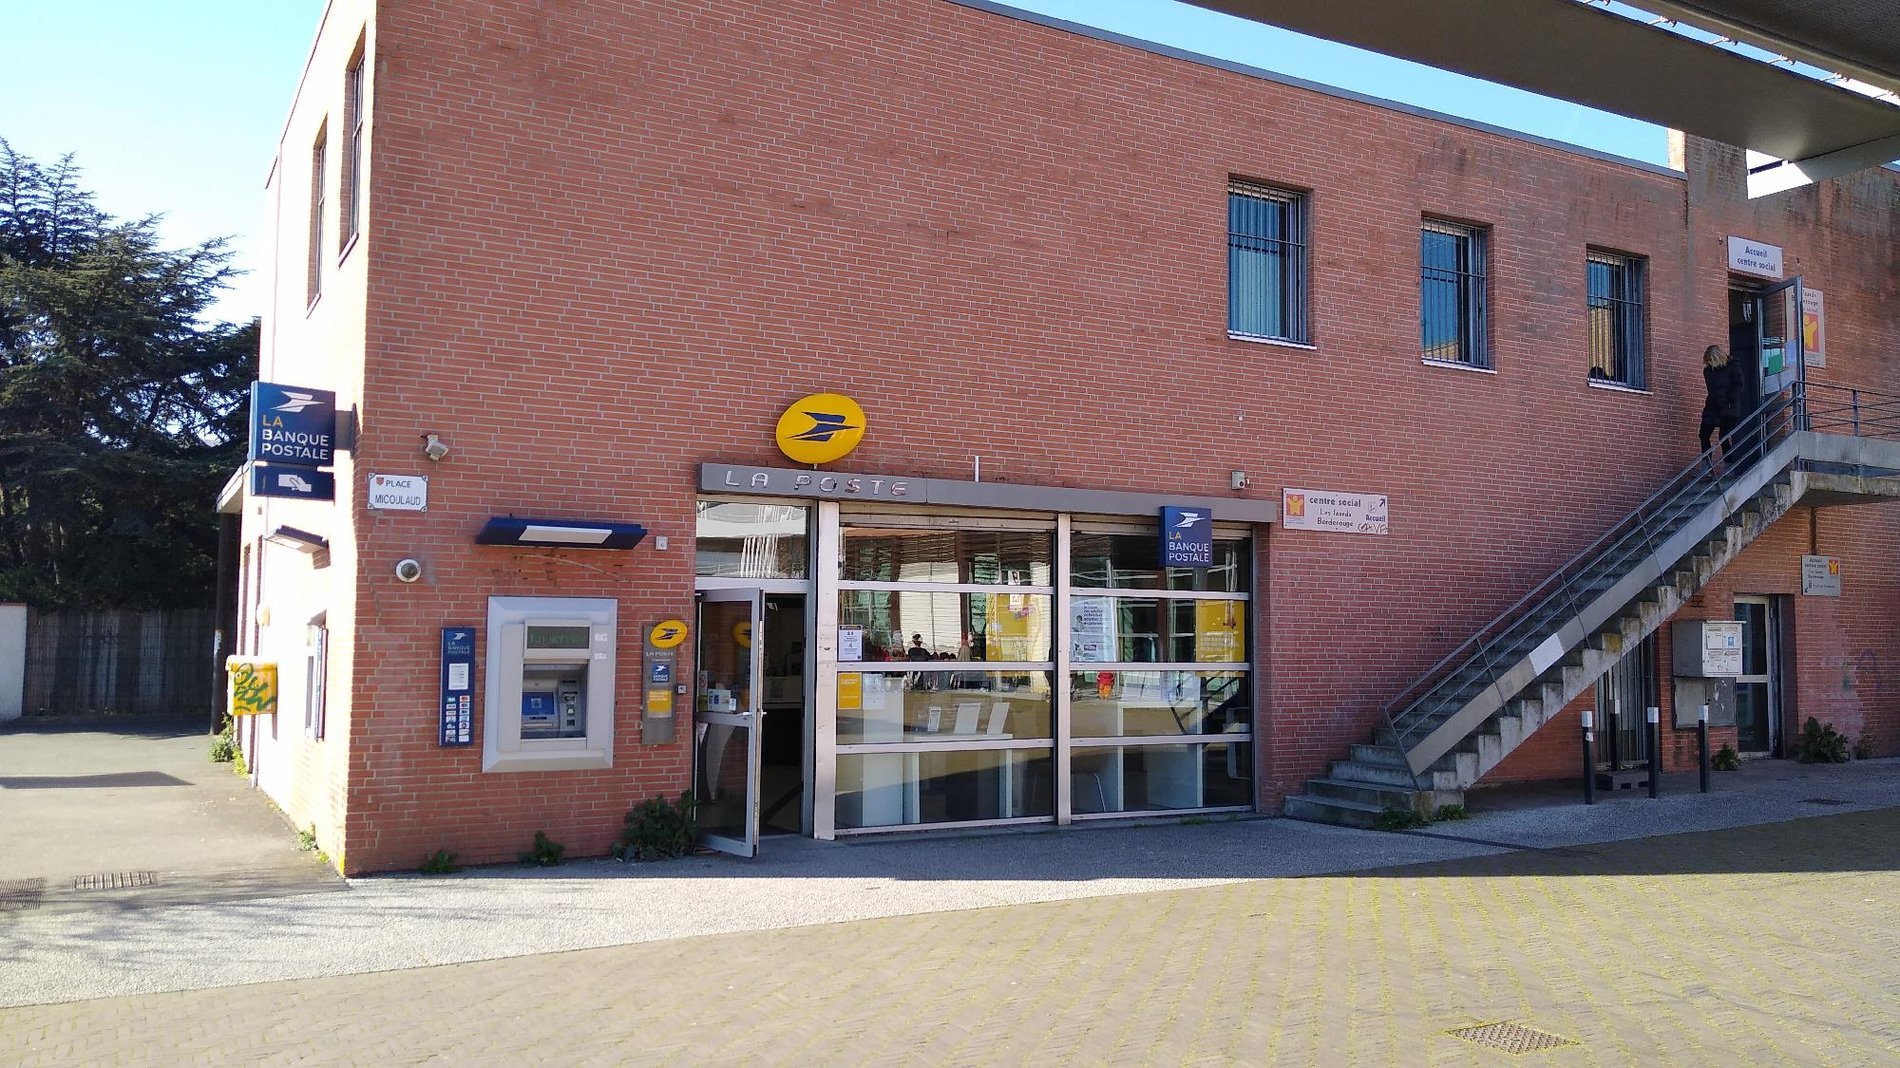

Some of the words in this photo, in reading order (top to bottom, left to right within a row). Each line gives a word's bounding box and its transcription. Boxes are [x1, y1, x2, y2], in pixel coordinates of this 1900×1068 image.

[1745, 246, 1768, 258] Accueil
[1737, 257, 1758, 268] centre
[1758, 262, 1776, 272] social
[262, 414, 283, 428] LA
[261, 429, 330, 447] BANQUE
[261, 442, 329, 460] POSTALE
[385, 479, 412, 489] PLACE
[725, 470, 769, 489] LA
[794, 475, 908, 497] POSTE
[374, 494, 422, 506] MICOULAUD
[1309, 497, 1336, 506] centre
[1338, 498, 1361, 508] social
[1365, 514, 1386, 523] Accueil
[1168, 531, 1182, 541] LA
[1168, 541, 1209, 554] BANQUE
[1168, 551, 1210, 563] POSTALE
